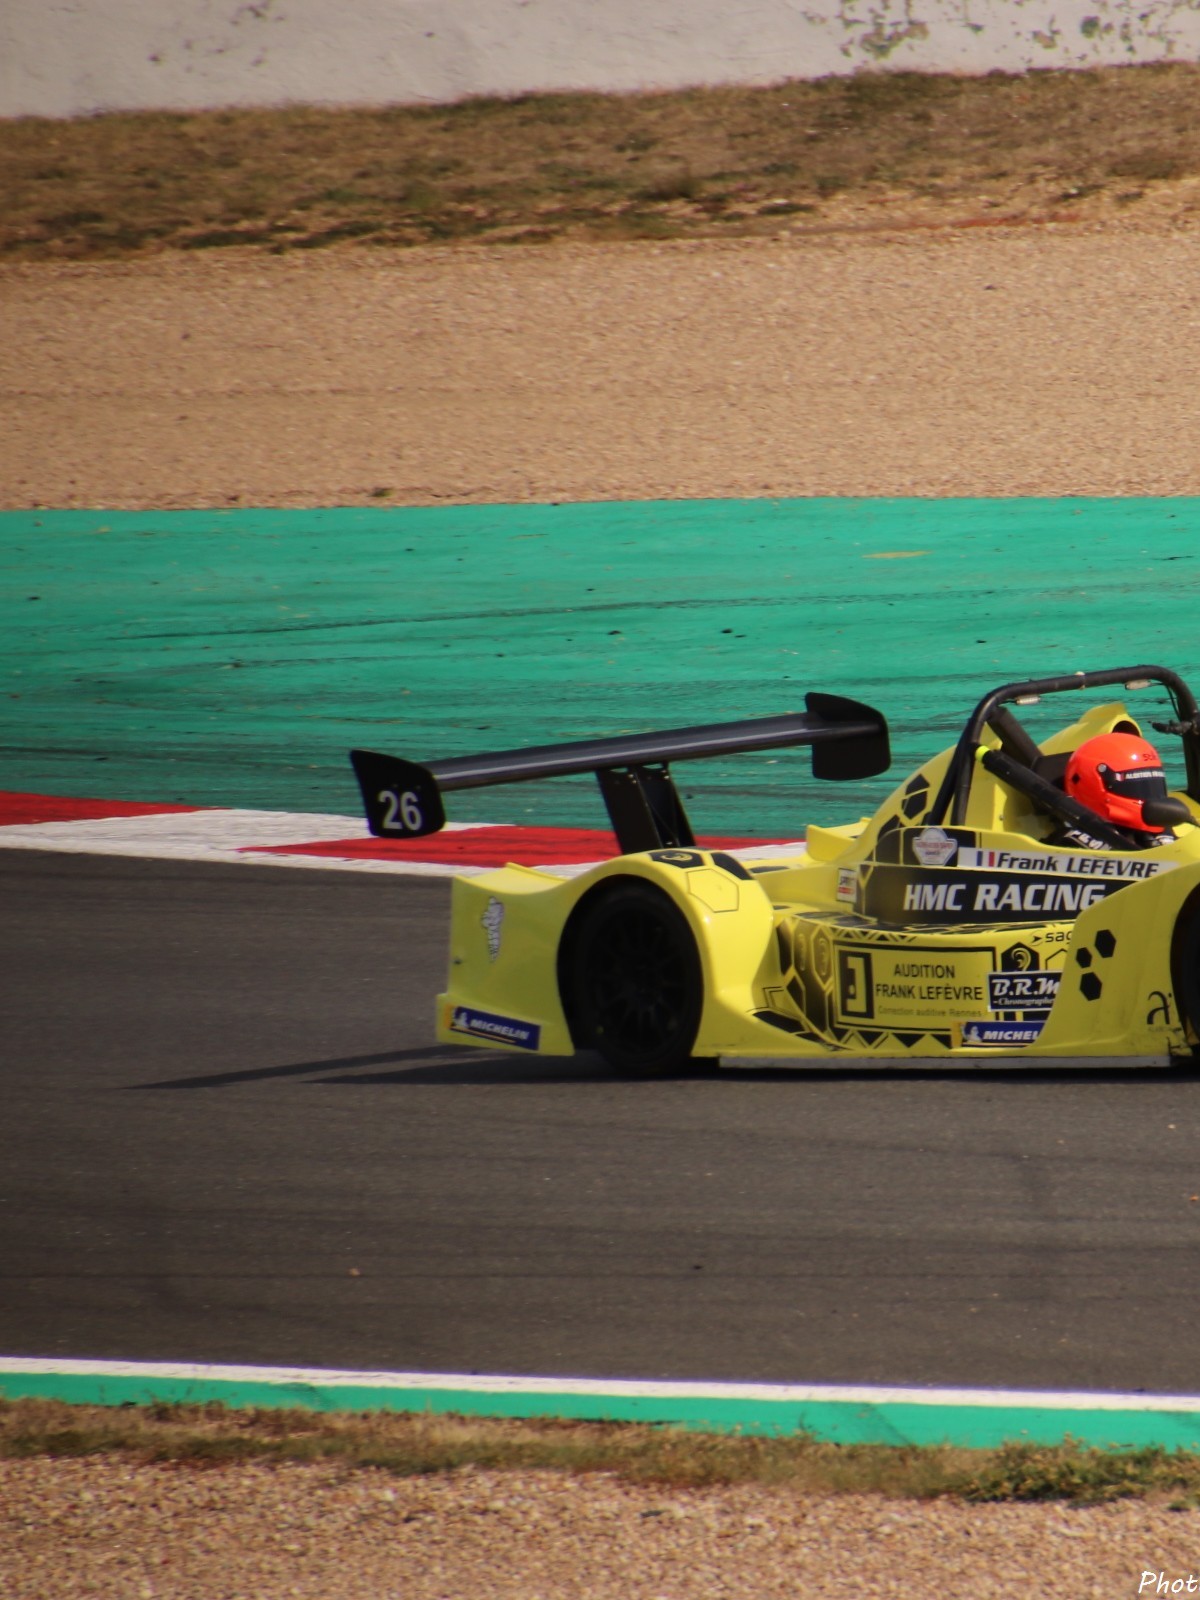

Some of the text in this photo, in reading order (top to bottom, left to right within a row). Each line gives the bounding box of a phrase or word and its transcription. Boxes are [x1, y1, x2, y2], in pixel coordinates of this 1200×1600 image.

[379, 790, 422, 830] 26
[997, 852, 1160, 878] Frank LEFEVRE
[903, 883, 1106, 911] HMC RACING
[893, 963, 956, 979] AUDITION
[875, 983, 917, 1000] FRANK
[470, 1018, 530, 1040] MICHELIN
[983, 1030, 1040, 1041] MICHEL
